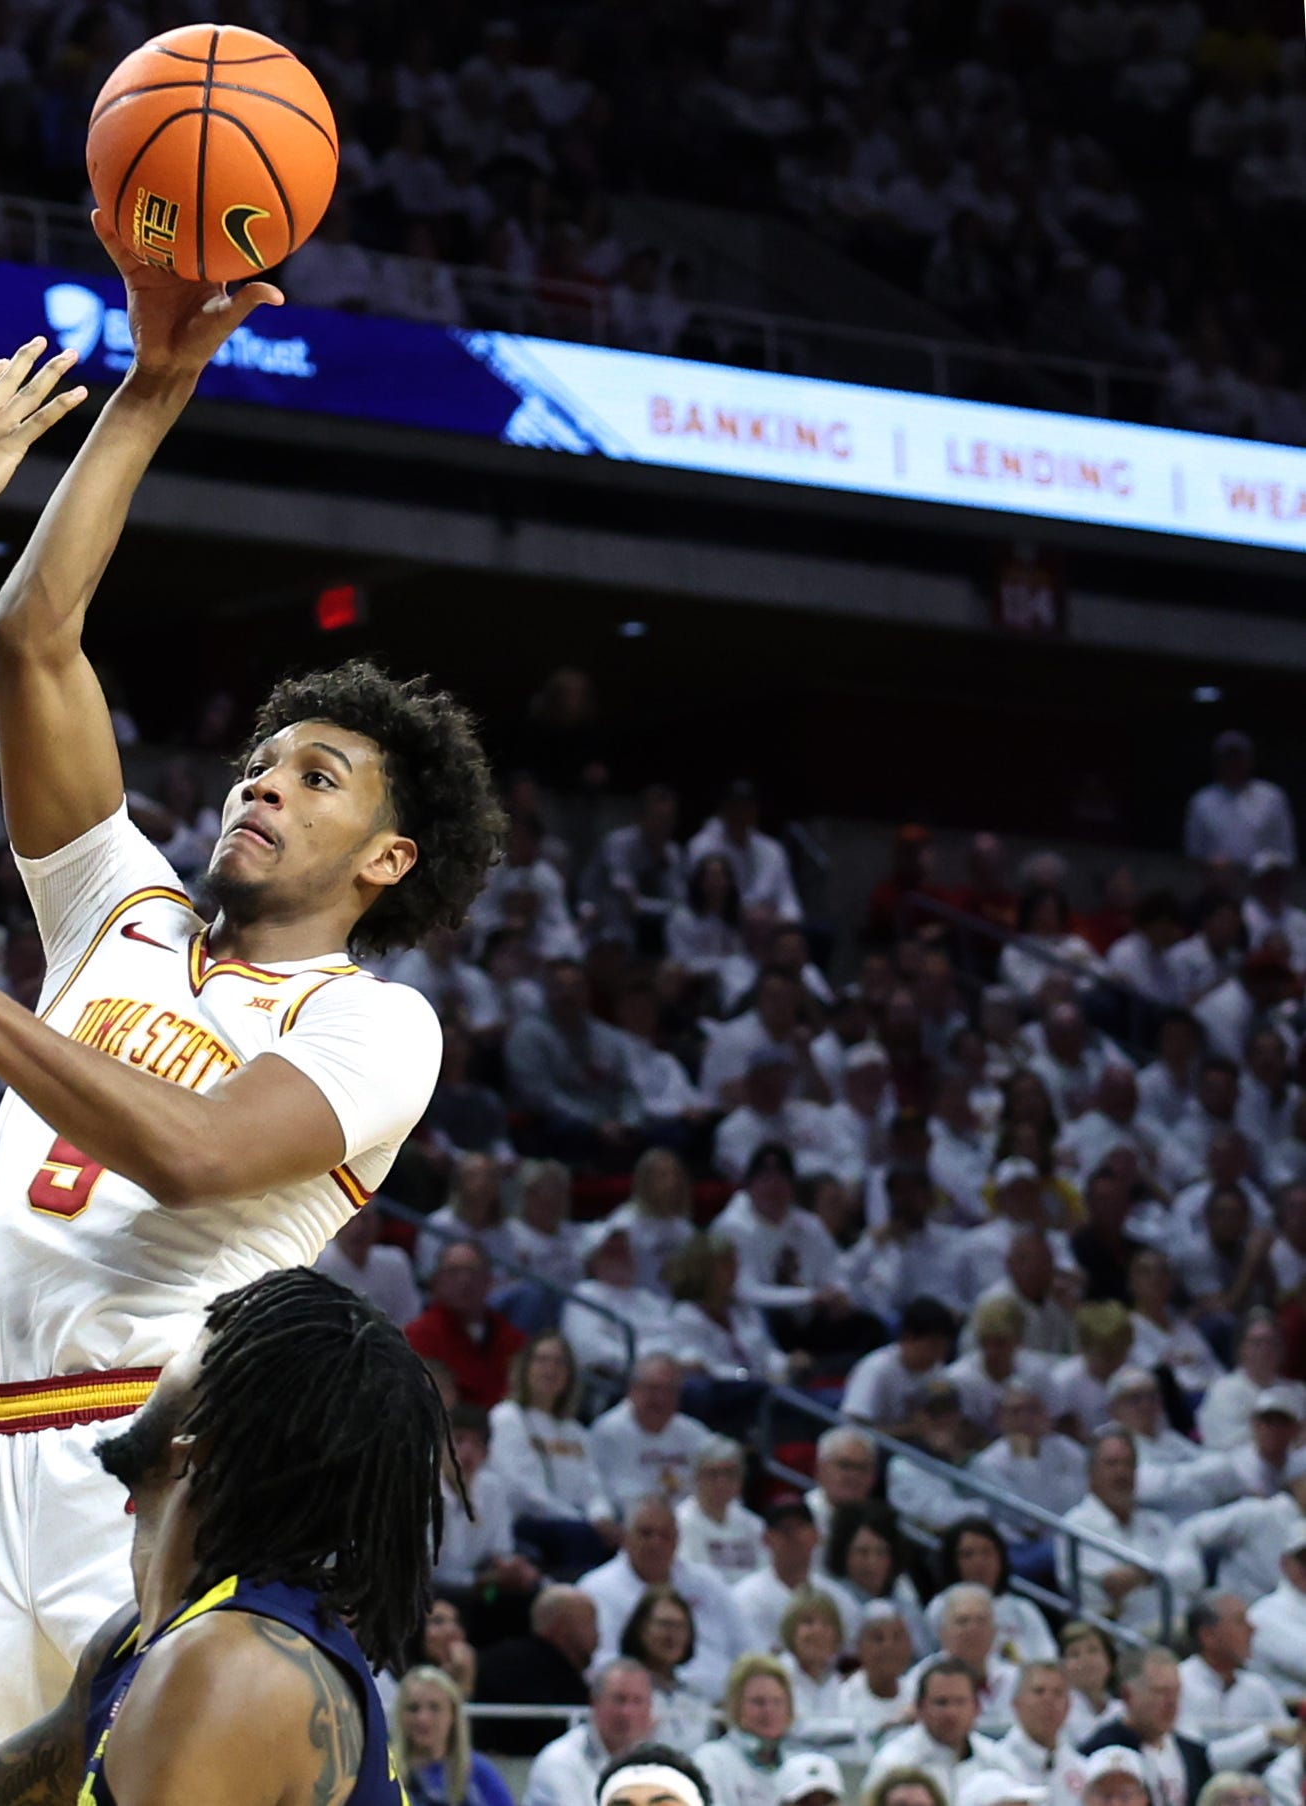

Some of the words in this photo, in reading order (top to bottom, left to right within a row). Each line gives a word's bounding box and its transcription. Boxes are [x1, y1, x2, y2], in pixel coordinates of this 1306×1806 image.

[142, 191, 180, 268] ELIT
[649, 394, 852, 461] BANKING
[945, 437, 1133, 497] LENDING
[243, 996, 281, 1012] XII
